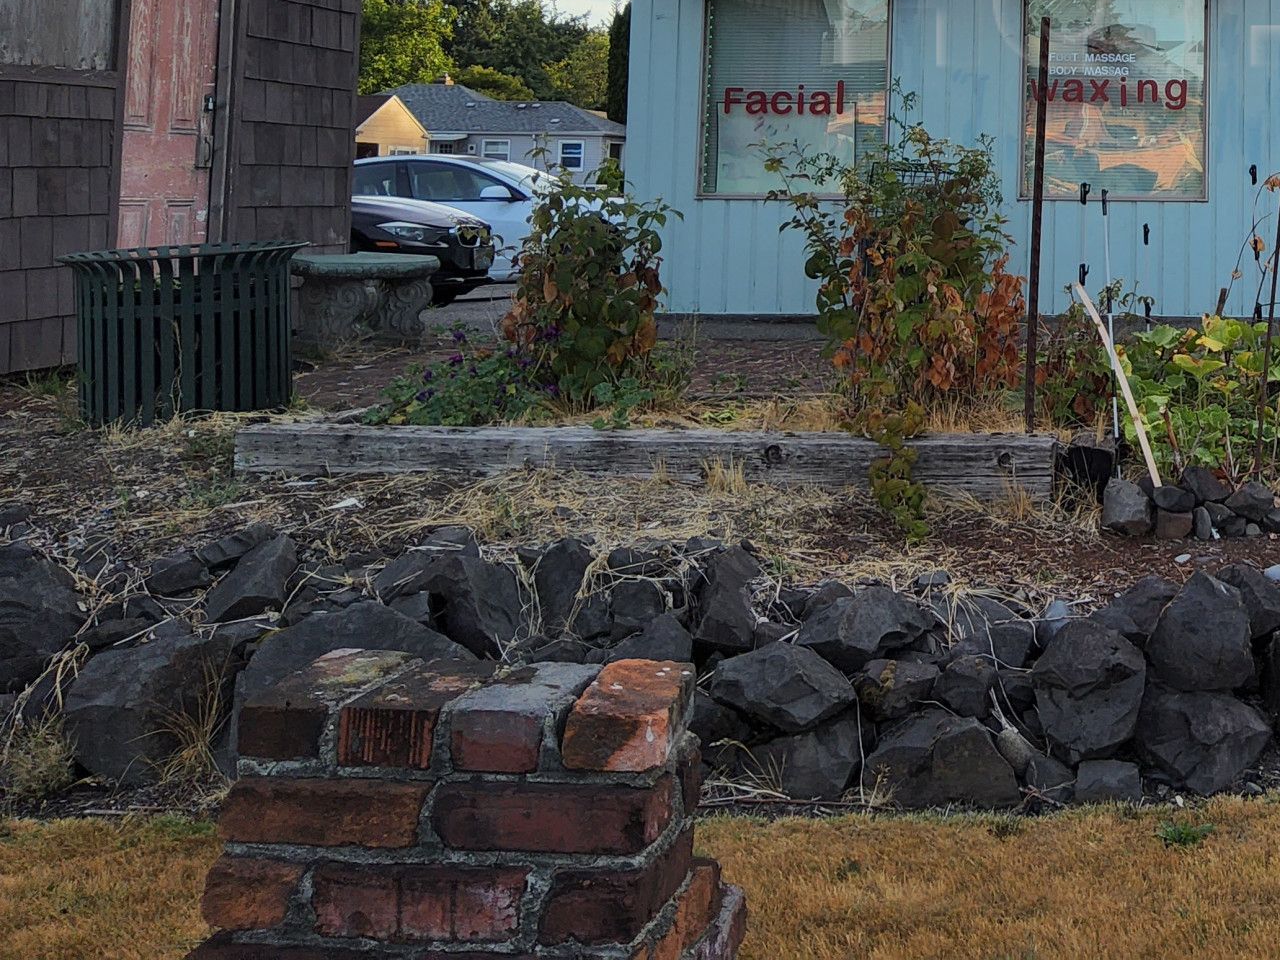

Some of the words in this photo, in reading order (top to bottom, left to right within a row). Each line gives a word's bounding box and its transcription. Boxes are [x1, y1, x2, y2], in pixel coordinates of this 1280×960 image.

[1084, 53, 1136, 63] MASSAGE
[1049, 66, 1078, 76] BODY
[1083, 66, 1129, 76] MASSAG
[724, 79, 845, 115] Facial
